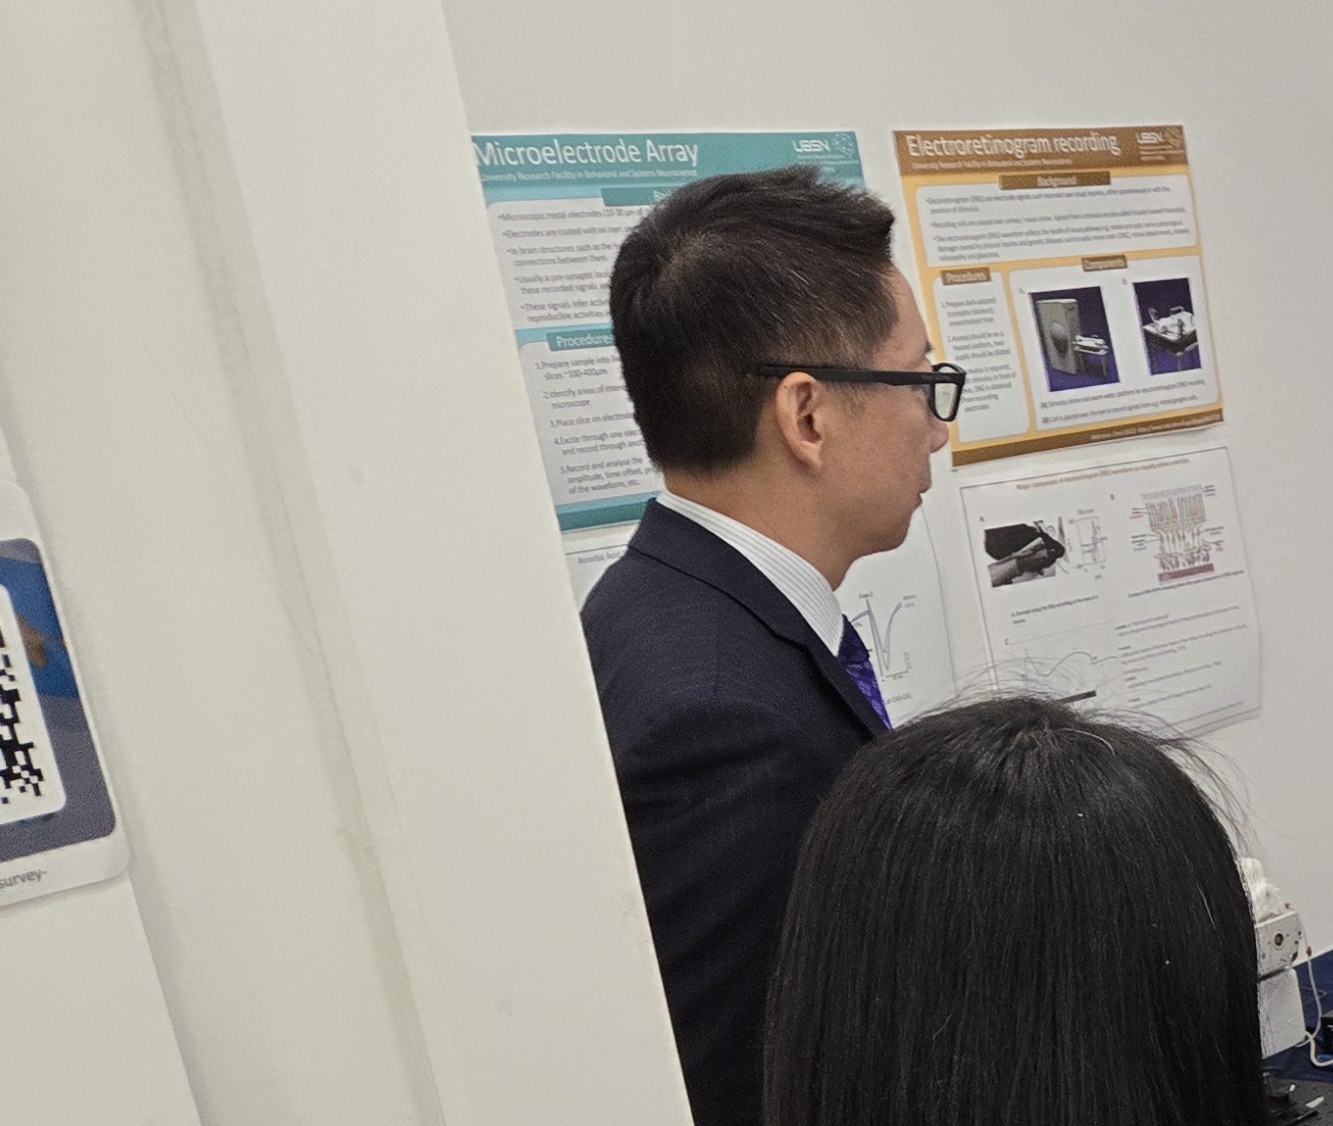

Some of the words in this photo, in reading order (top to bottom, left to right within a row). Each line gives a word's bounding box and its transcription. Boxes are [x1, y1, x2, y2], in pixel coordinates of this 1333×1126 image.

[474, 138, 641, 167] Microelectrode
[646, 139, 699, 167] Array
[905, 134, 1050, 160] Electroretinogram
[1052, 132, 1122, 157] recording
